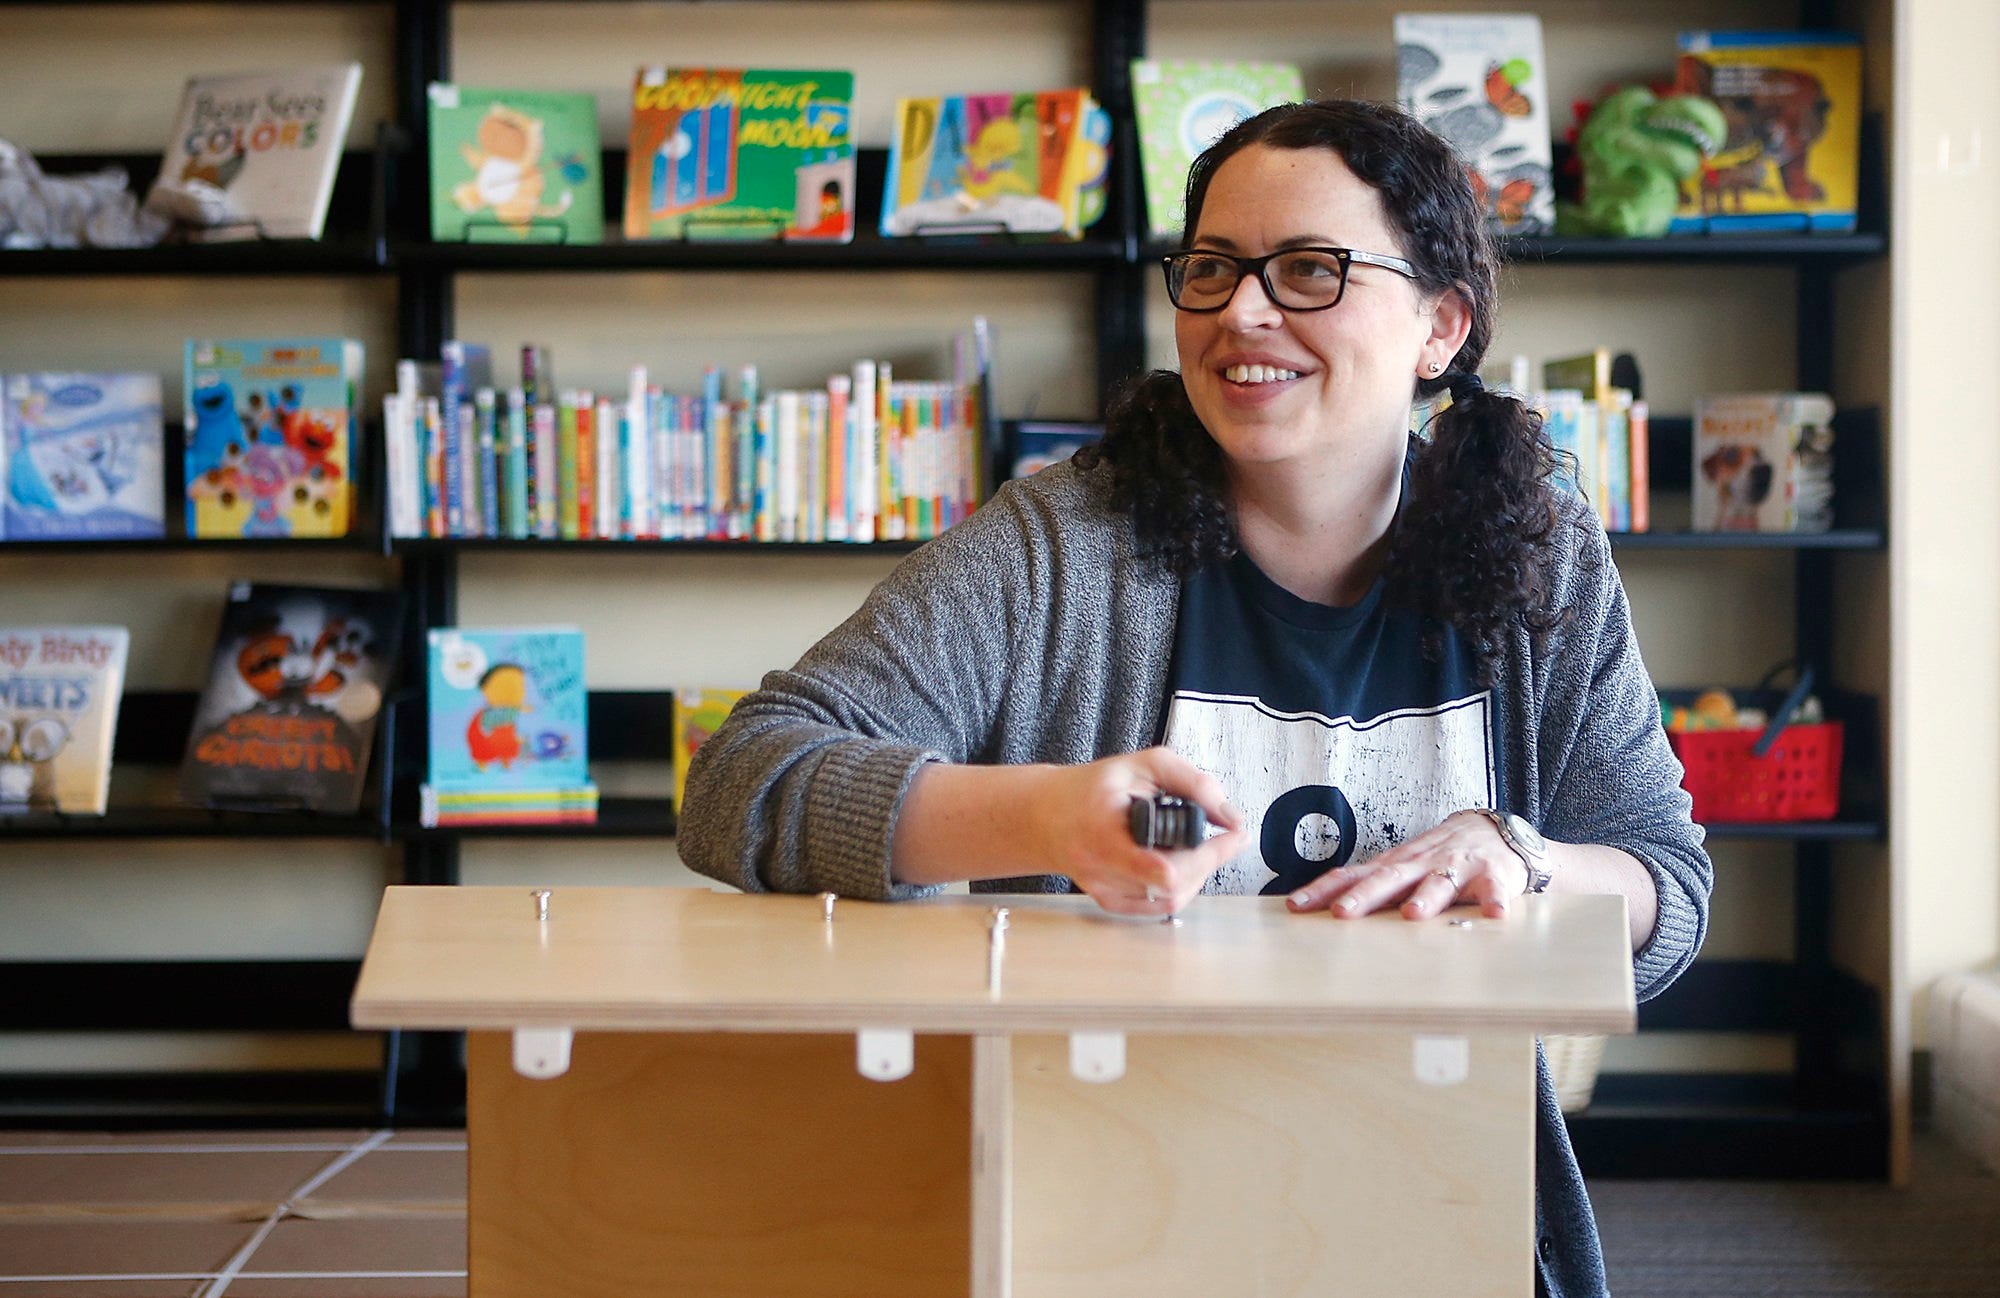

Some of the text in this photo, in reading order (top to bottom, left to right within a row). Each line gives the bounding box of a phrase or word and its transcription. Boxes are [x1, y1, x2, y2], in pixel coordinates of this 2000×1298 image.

[634, 76, 819, 112] GOODNIGHT
[184, 119, 320, 156] COLORS
[739, 118, 832, 148] MOON
